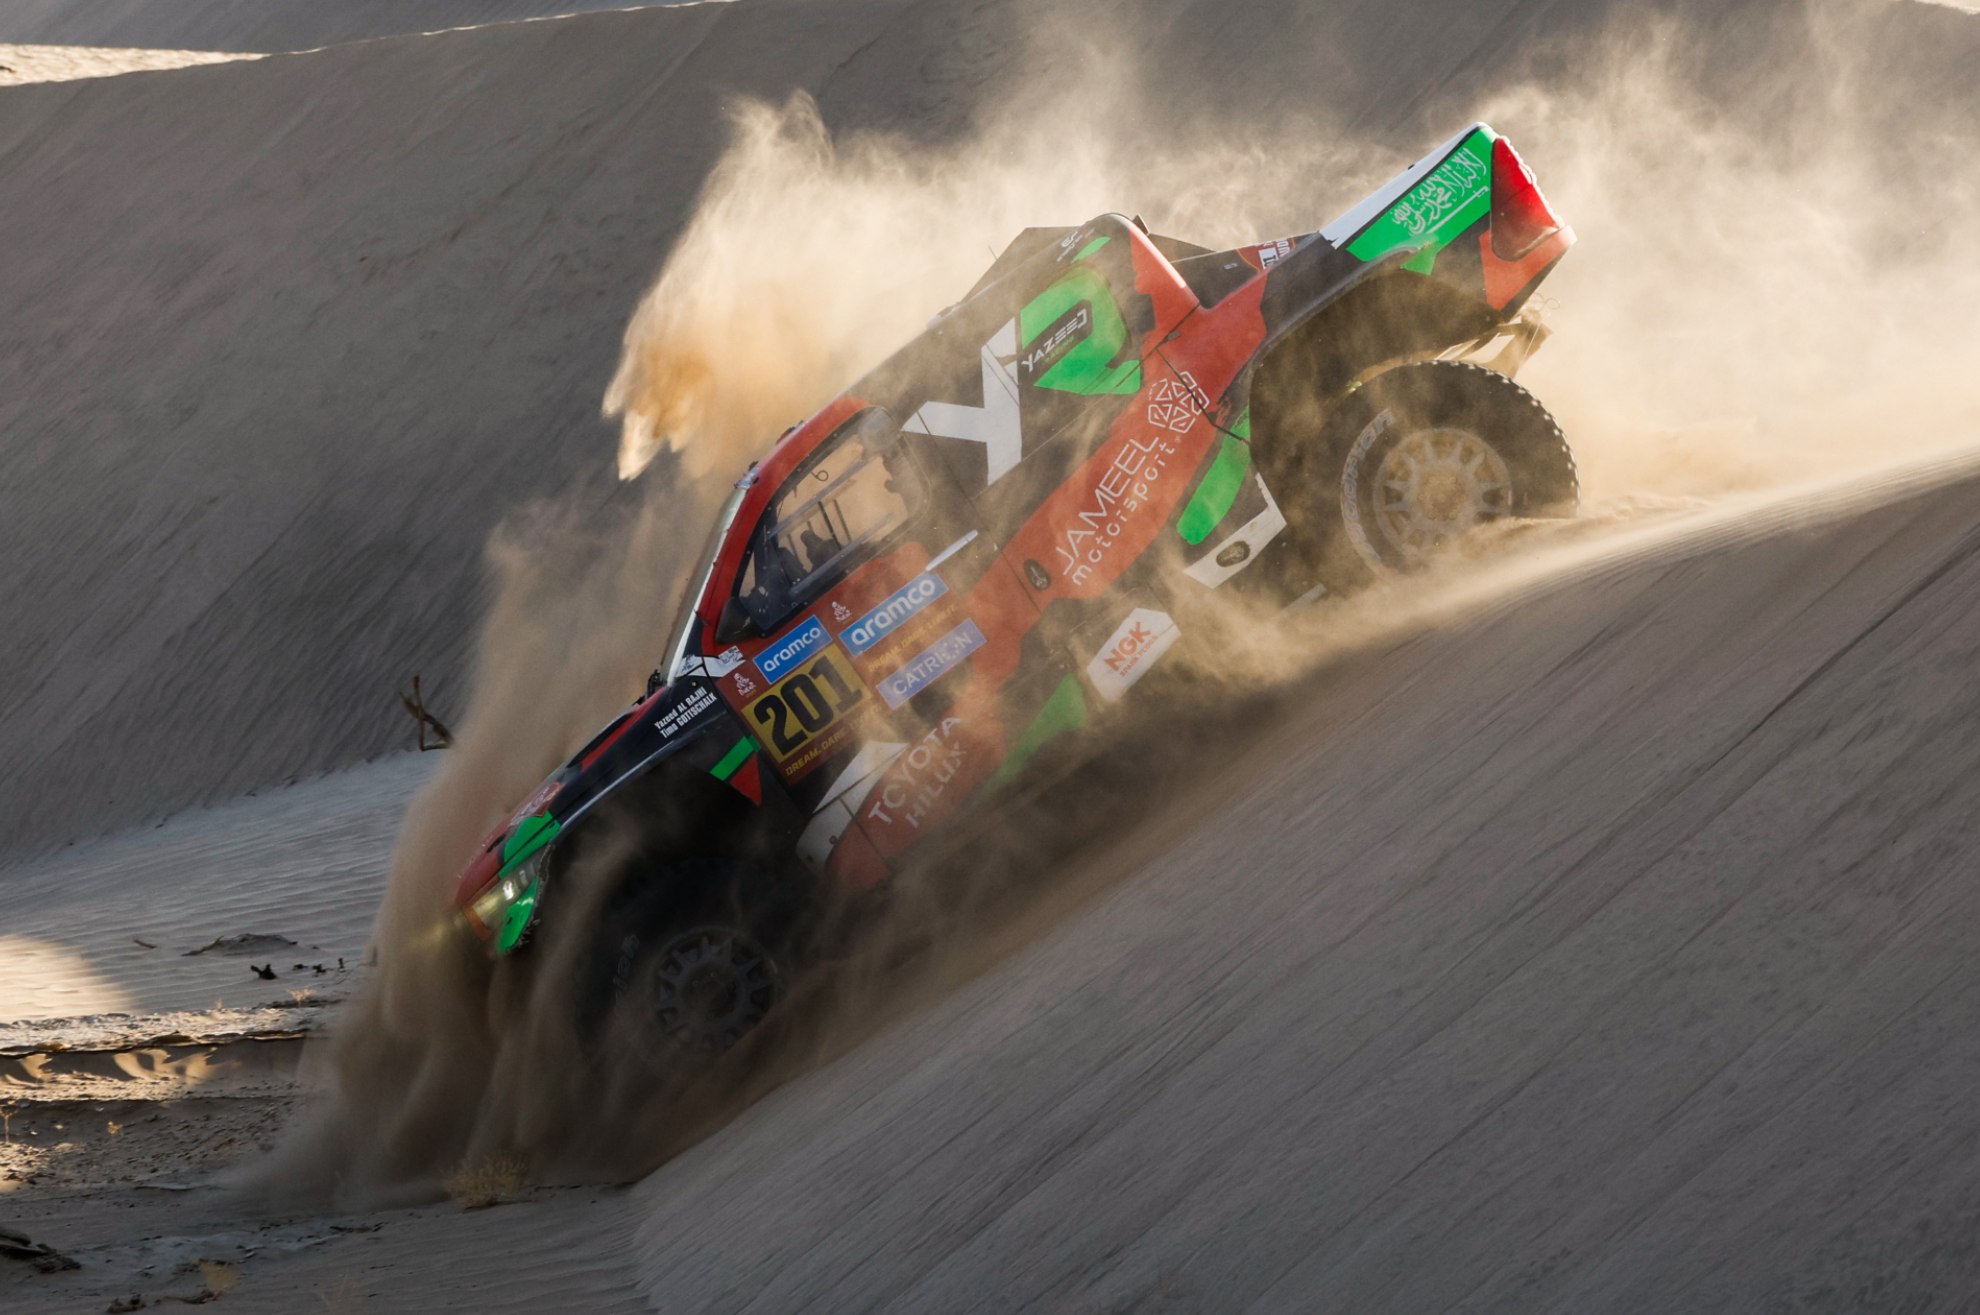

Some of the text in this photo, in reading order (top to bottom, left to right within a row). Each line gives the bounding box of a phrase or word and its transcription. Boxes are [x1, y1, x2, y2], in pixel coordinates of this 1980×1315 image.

[1021, 308, 1088, 373] YAZEED
[1056, 437, 1160, 576] JAMEEL
[1072, 442, 1176, 586] motorsport
[851, 579, 936, 646] aramco
[763, 627, 821, 672] aramco
[1103, 621, 1152, 672] NGK
[654, 686, 708, 730] Yazeed AL RAJHI
[660, 692, 718, 738] Timo GOTTSCHALK
[753, 655, 863, 756] 201
[868, 717, 964, 825] TOYOTA
[905, 740, 967, 828] HILUX
